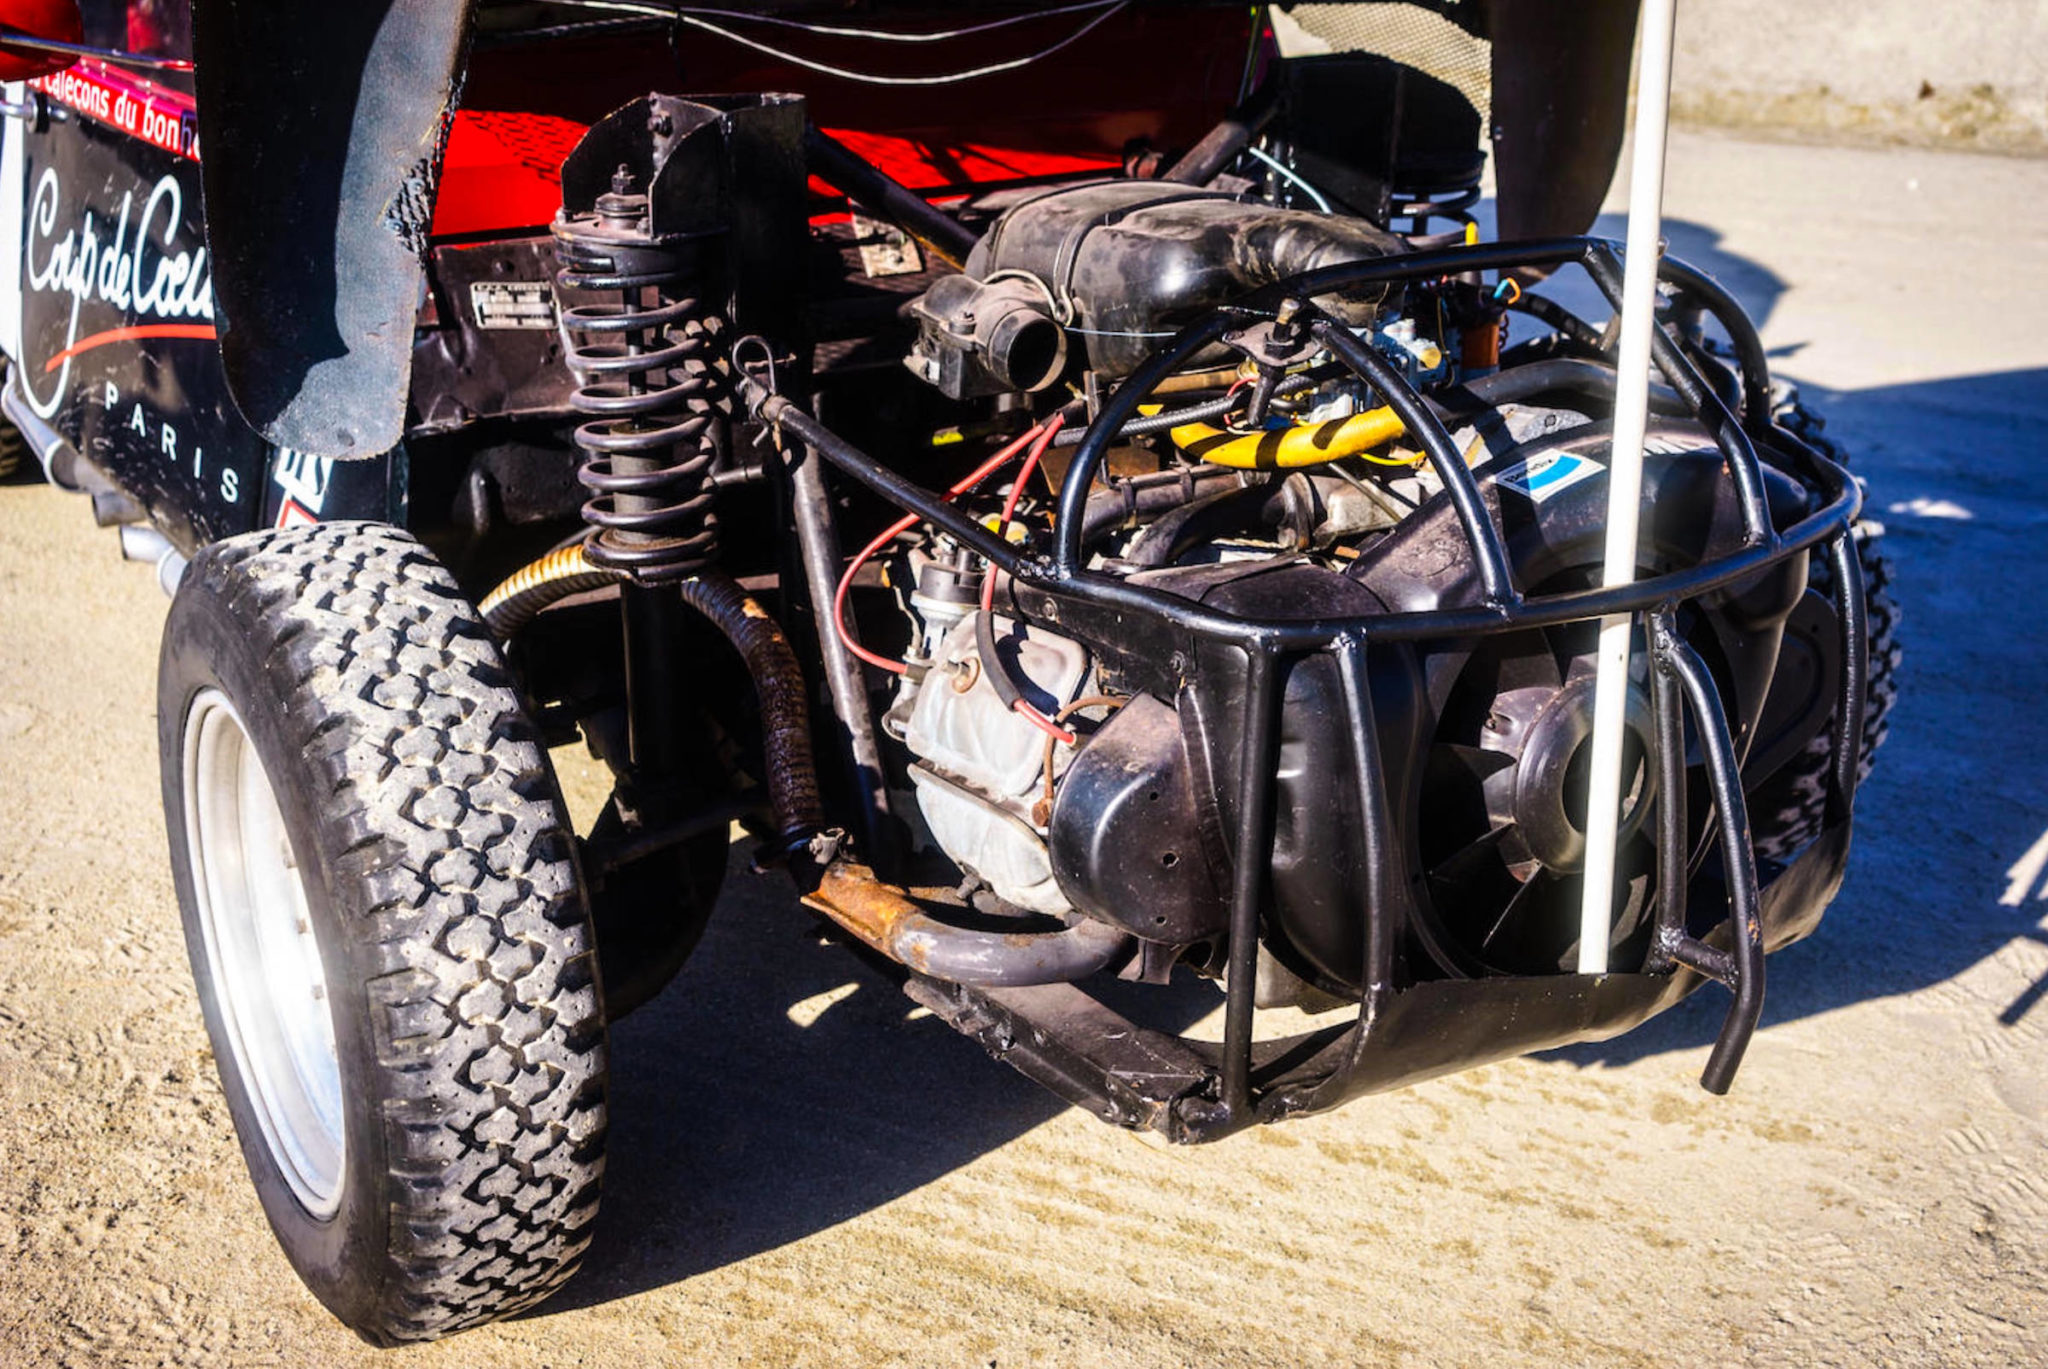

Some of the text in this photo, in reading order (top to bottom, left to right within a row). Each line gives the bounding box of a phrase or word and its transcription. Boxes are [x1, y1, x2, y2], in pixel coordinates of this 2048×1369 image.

[114, 89, 138, 131] du
[17, 166, 99, 420] Coup
[98, 190, 132, 311] de
[105, 379, 239, 504] PARIS
